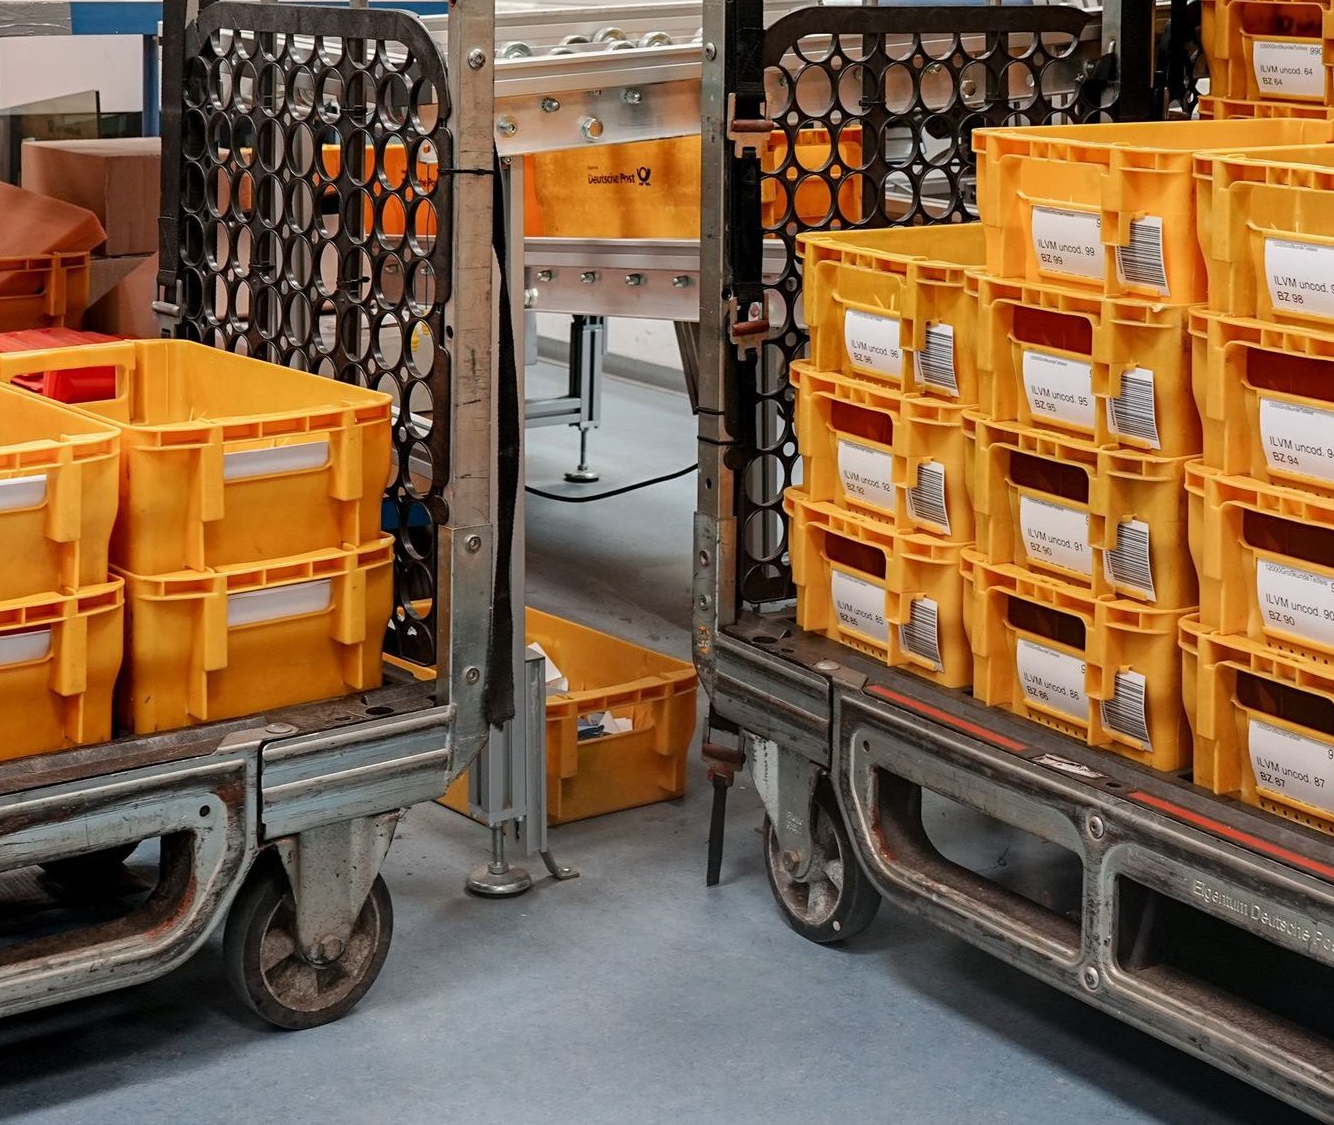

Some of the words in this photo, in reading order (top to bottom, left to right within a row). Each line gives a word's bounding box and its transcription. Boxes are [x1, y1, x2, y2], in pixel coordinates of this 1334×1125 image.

[588, 174, 619, 184] Deutsche
[620, 174, 635, 184] Post
[1038, 239, 1057, 250] ILVM
[1085, 246, 1095, 257] 99
[1040, 253, 1052, 263] BZ
[1053, 255, 1063, 265] 99
[1274, 275, 1297, 288] ILVM
[1299, 282, 1329, 293] uncod.
[1277, 291, 1291, 302] BZ
[1292, 293, 1304, 304] 98
[851, 340, 867, 351] ILVM
[890, 349, 899, 359] 96
[853, 352, 864, 363] BZ
[864, 355, 873, 364] 96
[1031, 386, 1051, 397] ILVM
[1077, 396, 1088, 407] 95
[1034, 399, 1046, 410] BZ
[1046, 402, 1057, 412] 95
[1269, 436, 1293, 450] ILVM
[1295, 444, 1324, 457] uncod.
[1272, 451, 1286, 463] BZ
[1287, 455, 1299, 466] 94
[844, 470, 860, 482] ILVM
[882, 482, 890, 492] 92
[846, 482, 857, 492] BZ
[856, 486, 865, 495] 92
[1027, 528, 1047, 541] ILVM
[1074, 542, 1083, 552] 91
[1030, 542, 1042, 553] BZ
[1042, 546, 1052, 556] 90
[1265, 593, 1289, 608] ILVM
[1291, 603, 1321, 617] uncod.
[1323, 609, 1334, 621] 90
[1268, 610, 1282, 622] BZ
[1283, 615, 1295, 626] 90
[1024, 672, 1043, 686] ILVM
[1069, 689, 1080, 701] 86
[1026, 685, 1038, 697] BZ
[1038, 690, 1049, 701] 86
[1256, 756, 1280, 773] ILVM
[1281, 767, 1311, 784] uncod.
[1313, 776, 1325, 788] 87
[1260, 771, 1274, 784] BZ
[1274, 777, 1285, 788] 87
[1193, 881, 1249, 918] Eigentum
[1251, 905, 1310, 942] Deutsche
